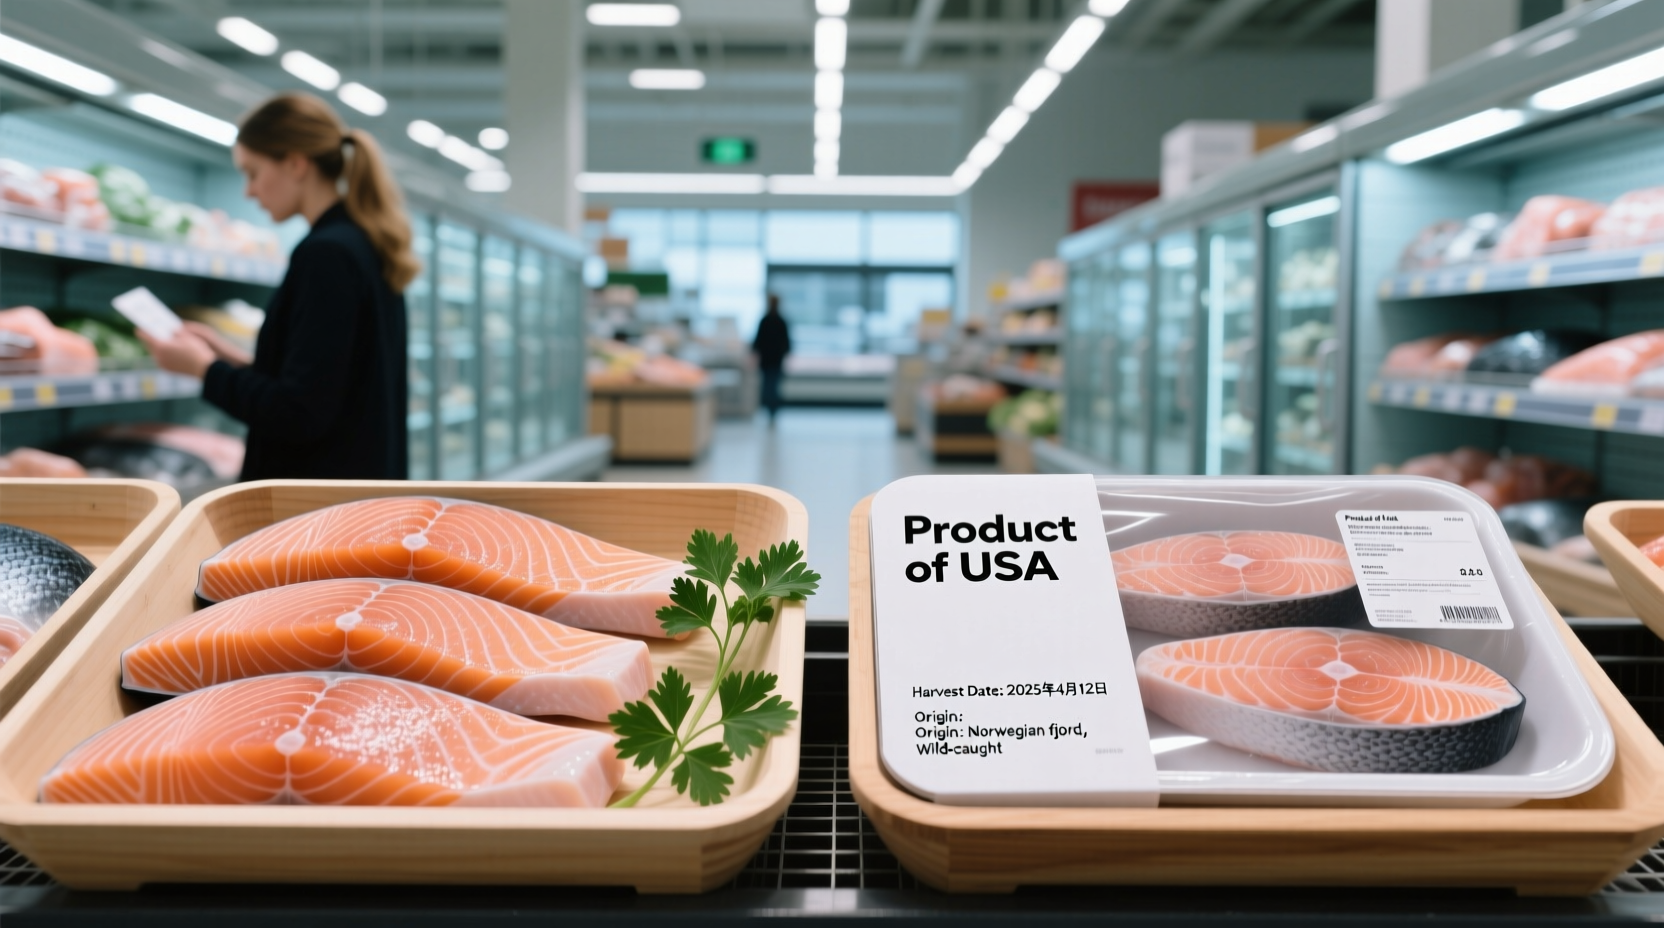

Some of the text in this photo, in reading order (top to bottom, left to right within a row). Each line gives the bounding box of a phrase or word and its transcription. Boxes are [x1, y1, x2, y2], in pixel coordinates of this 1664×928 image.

[904, 514, 1077, 544] Product
[905, 550, 1059, 583] of USA
[912, 682, 1108, 698] Harvest Date: 2025年4月12日
[914, 710, 963, 725] Origin:
[915, 723, 1087, 741] Origin: Norwegian fjord,
[916, 741, 1003, 758] Wild-caught
